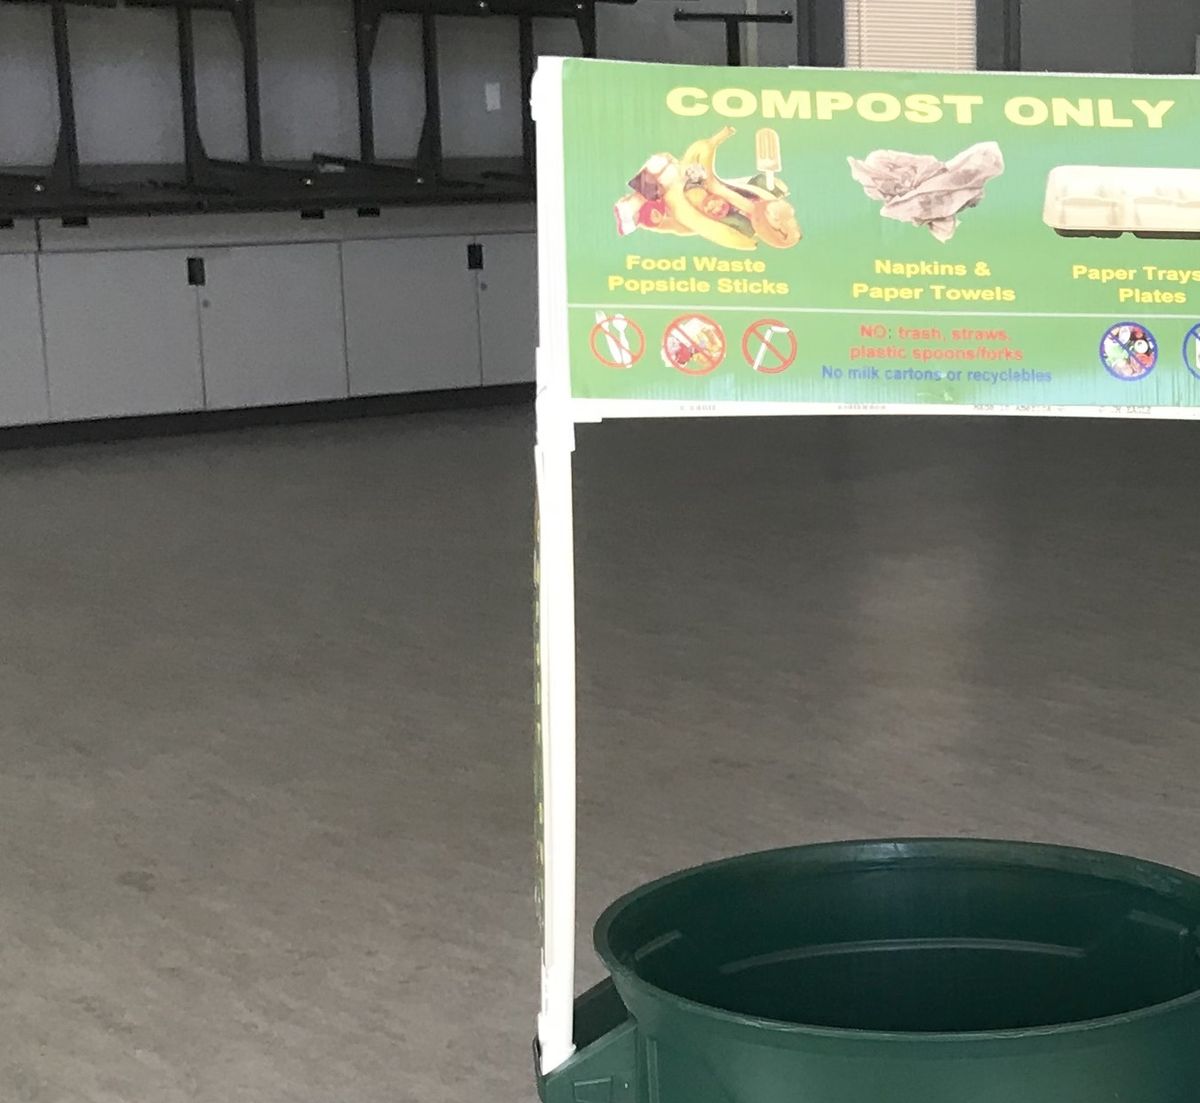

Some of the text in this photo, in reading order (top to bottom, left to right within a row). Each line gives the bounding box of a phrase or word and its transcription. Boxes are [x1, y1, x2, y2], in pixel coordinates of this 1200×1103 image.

[667, 87, 1174, 127] COMPOST ONLY
[626, 255, 765, 273] Food Waste
[875, 260, 990, 277] Napkins &
[1072, 265, 1136, 282] Paper
[608, 276, 788, 294] Popsicle Sticks
[853, 283, 1015, 301] Paper Towels
[1119, 288, 1186, 303] Plates
[850, 345, 907, 360] plastic
[821, 365, 1053, 384] No milk cartons or recyclables
